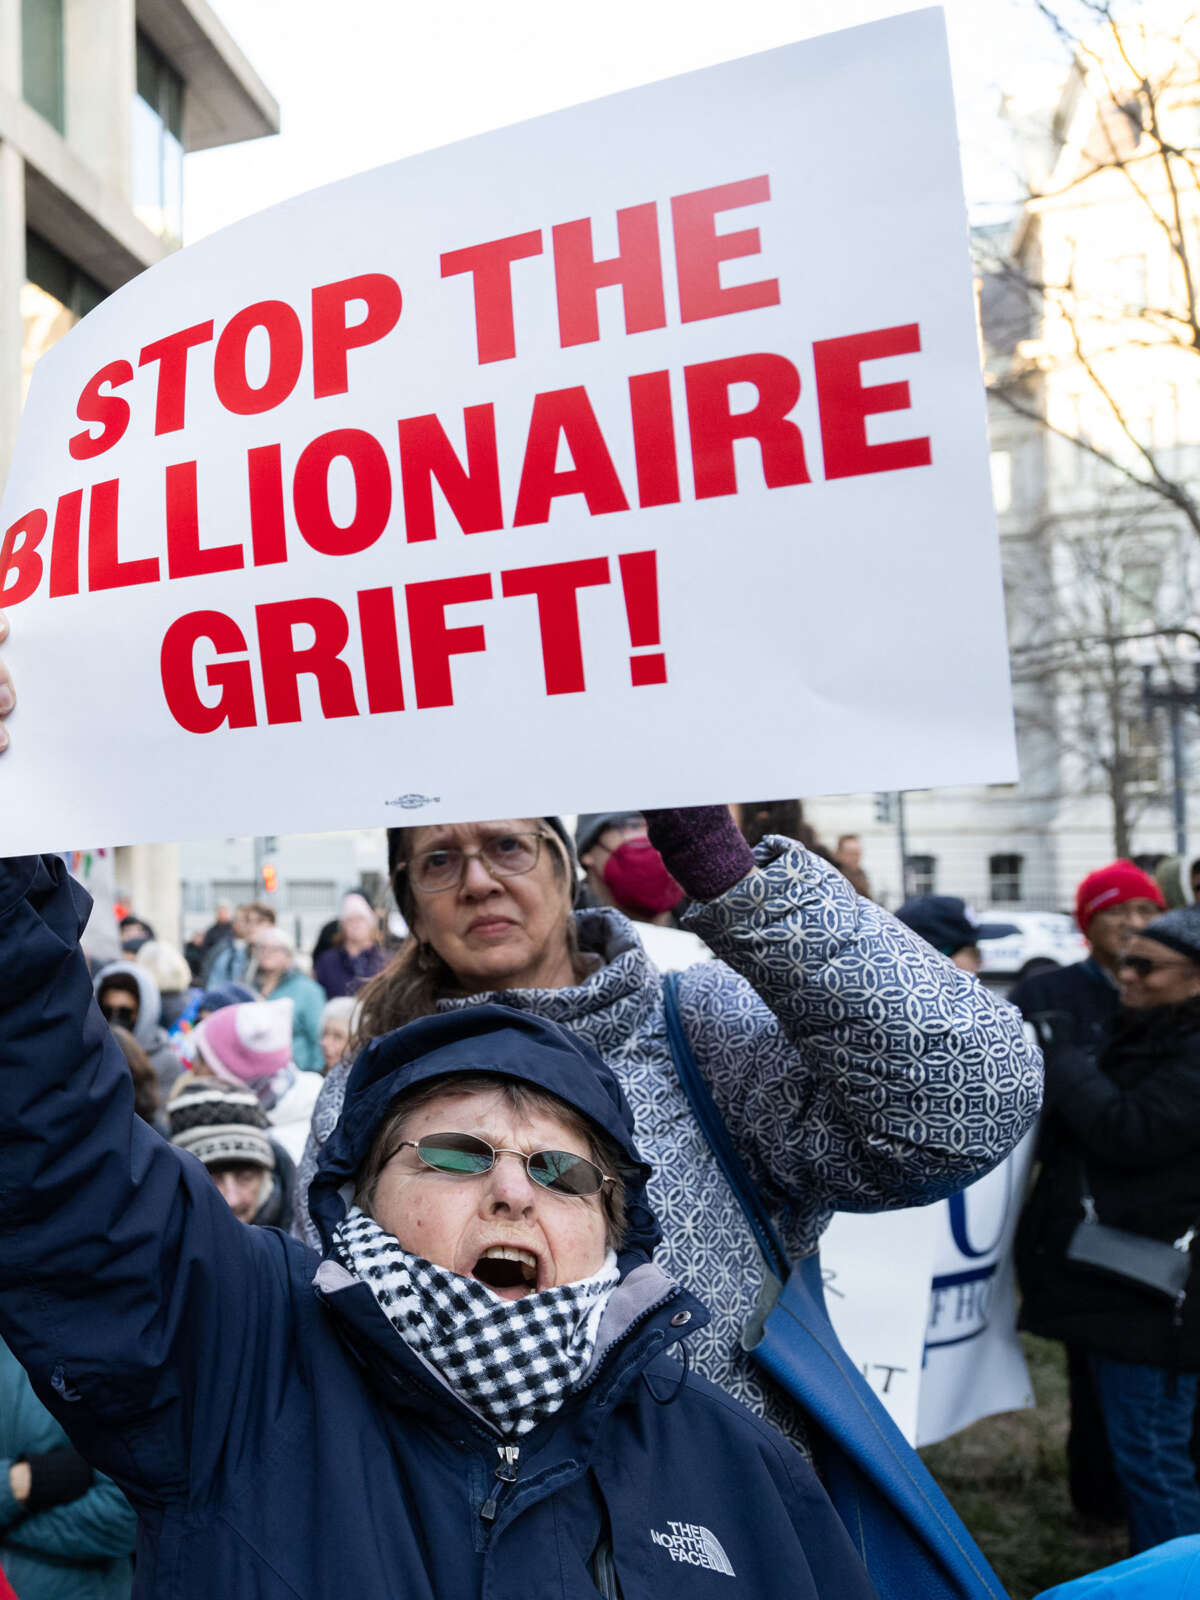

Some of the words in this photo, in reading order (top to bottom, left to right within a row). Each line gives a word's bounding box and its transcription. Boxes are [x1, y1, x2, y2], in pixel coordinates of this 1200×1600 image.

[68, 273, 403, 461] STOP
[439, 174, 781, 365] THE
[160, 549, 668, 735] GRIFT!
[650, 1529, 705, 1554] NORTH
[667, 1521, 702, 1540] THE
[669, 1548, 711, 1569] FACE
